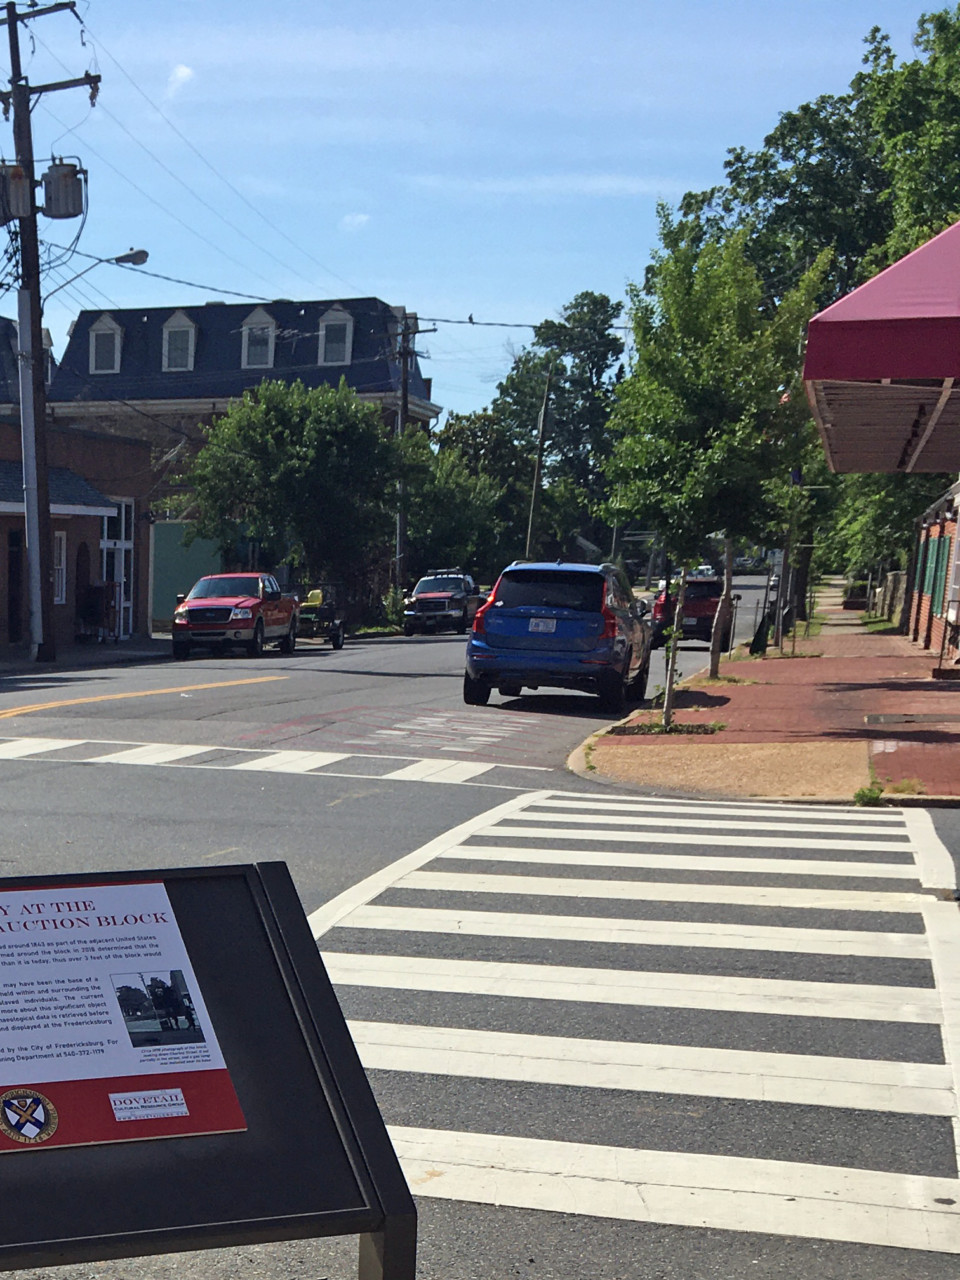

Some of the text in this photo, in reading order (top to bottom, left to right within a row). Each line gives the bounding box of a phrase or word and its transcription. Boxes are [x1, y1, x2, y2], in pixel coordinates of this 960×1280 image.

[19, 903, 46, 915] AT
[50, 900, 95, 913] THE
[97, 912, 168, 927] BLOCK
[89, 937, 114, 945] adjacent
[51, 985, 89, 994] surrounding
[53, 1003, 85, 1011] significant
[87, 1001, 106, 1009] object
[11, 1023, 41, 1032] displayed
[64, 1018, 112, 1028] Fredericksburg
[30, 1044, 43, 1052] City
[16, 1052, 54, 1062] Department
[112, 1093, 183, 1106] DOVETAIL
